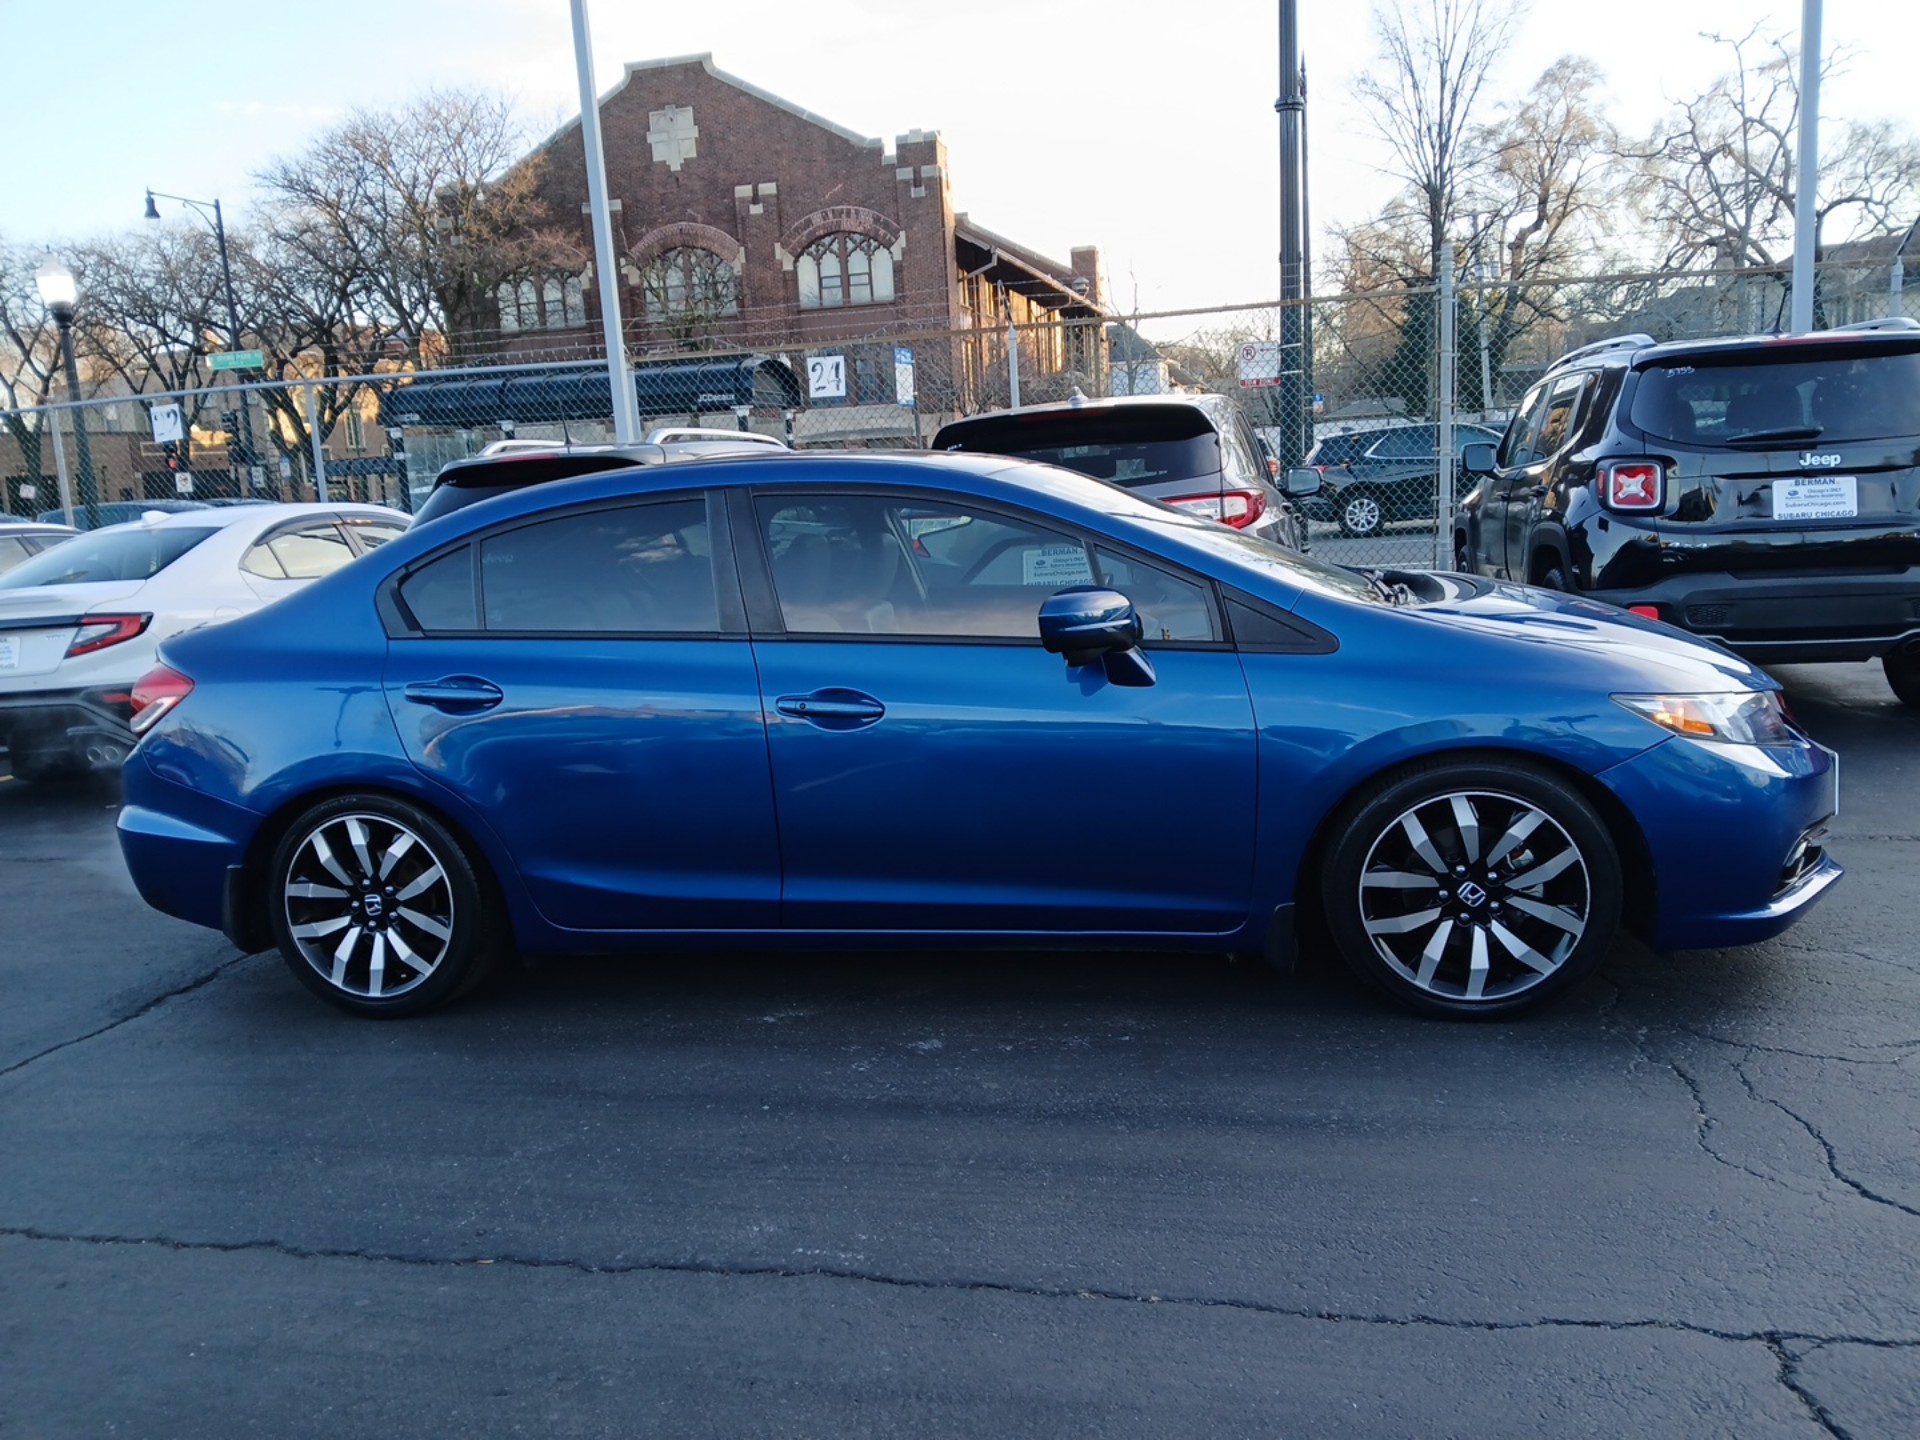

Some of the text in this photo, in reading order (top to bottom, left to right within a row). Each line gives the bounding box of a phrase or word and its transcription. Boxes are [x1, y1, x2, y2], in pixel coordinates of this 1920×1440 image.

[811, 361, 842, 392] 24
[1799, 453, 1842, 467] Jeep
[1794, 478, 1836, 486] BERMAN
[1777, 510, 1855, 519] SUBARU CHICAGO
[1041, 548, 1078, 556] BERMAN
